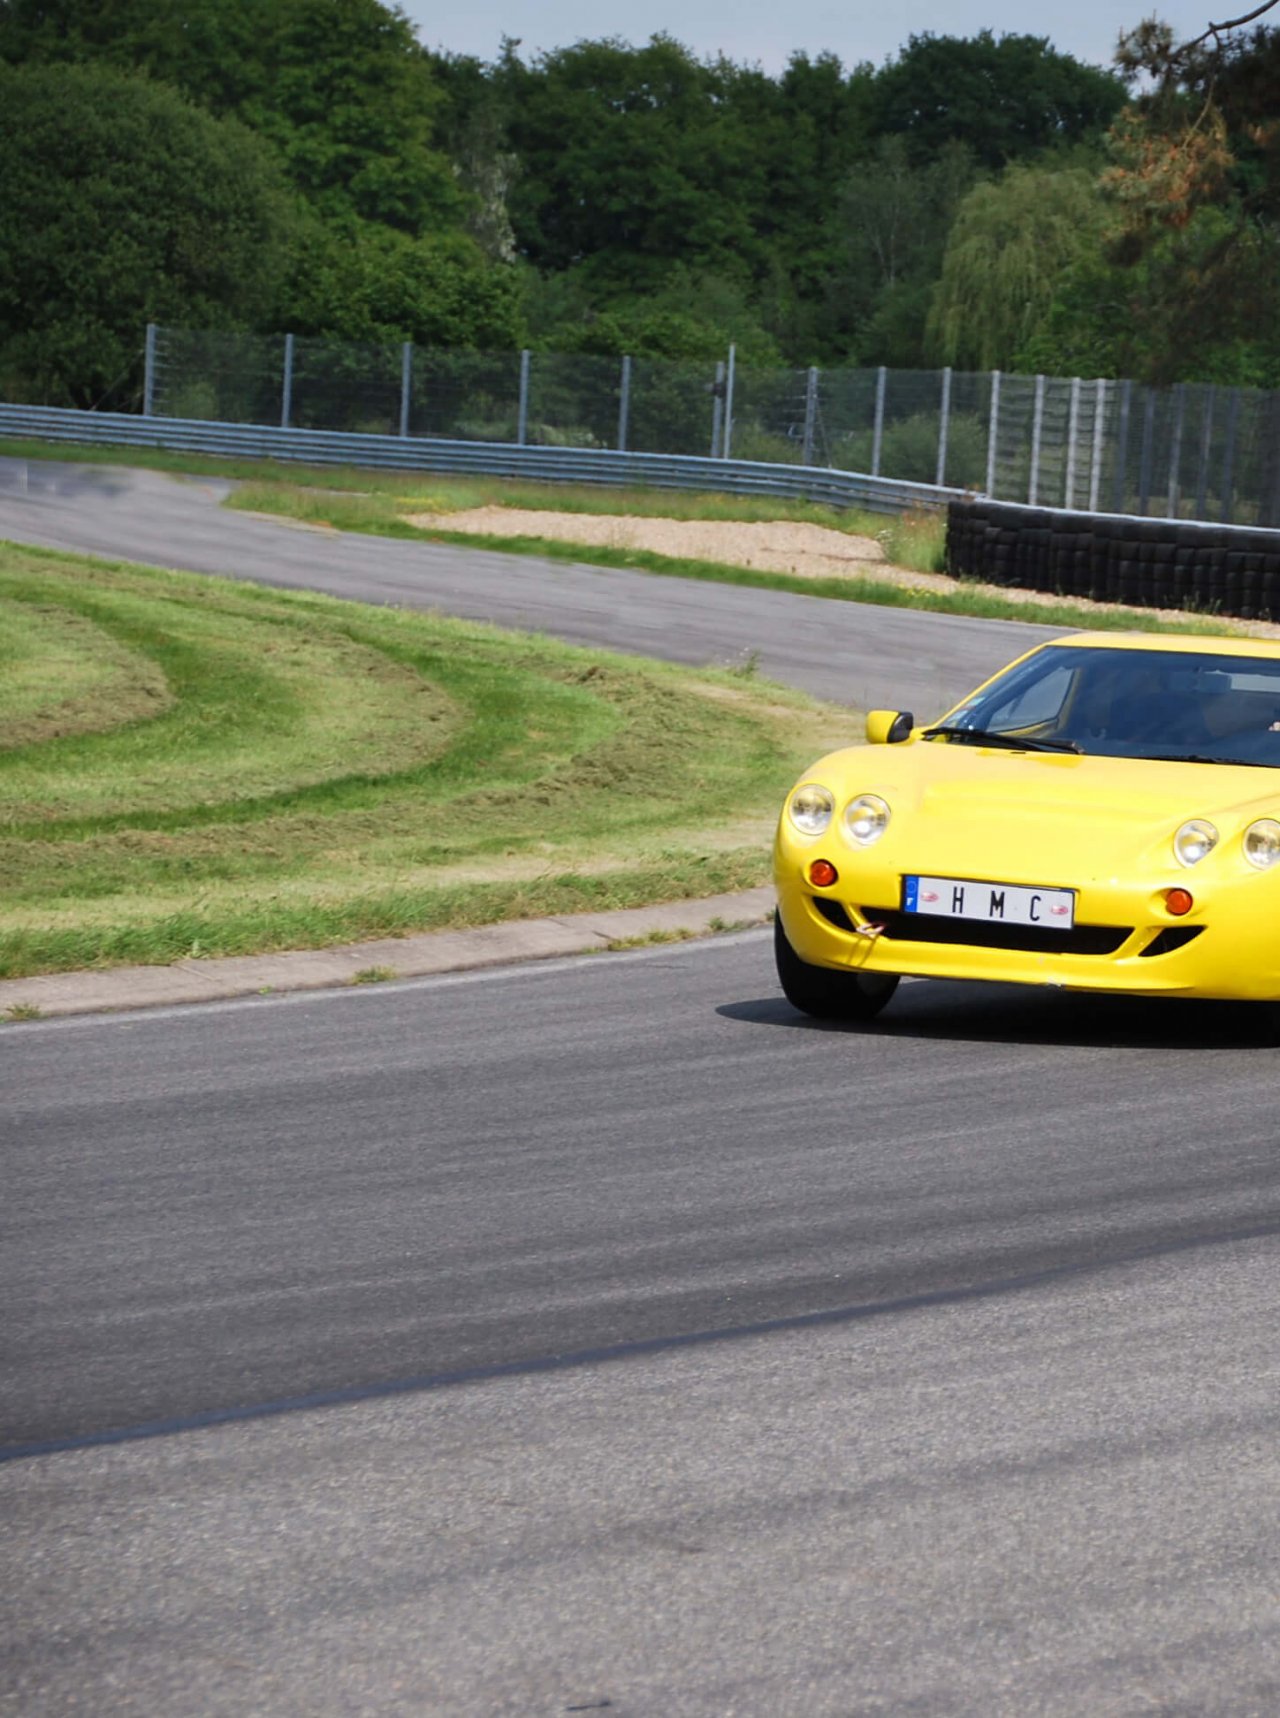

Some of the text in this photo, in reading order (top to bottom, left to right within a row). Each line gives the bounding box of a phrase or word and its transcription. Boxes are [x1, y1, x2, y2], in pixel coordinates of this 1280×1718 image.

[952, 886, 1042, 922] H M C
